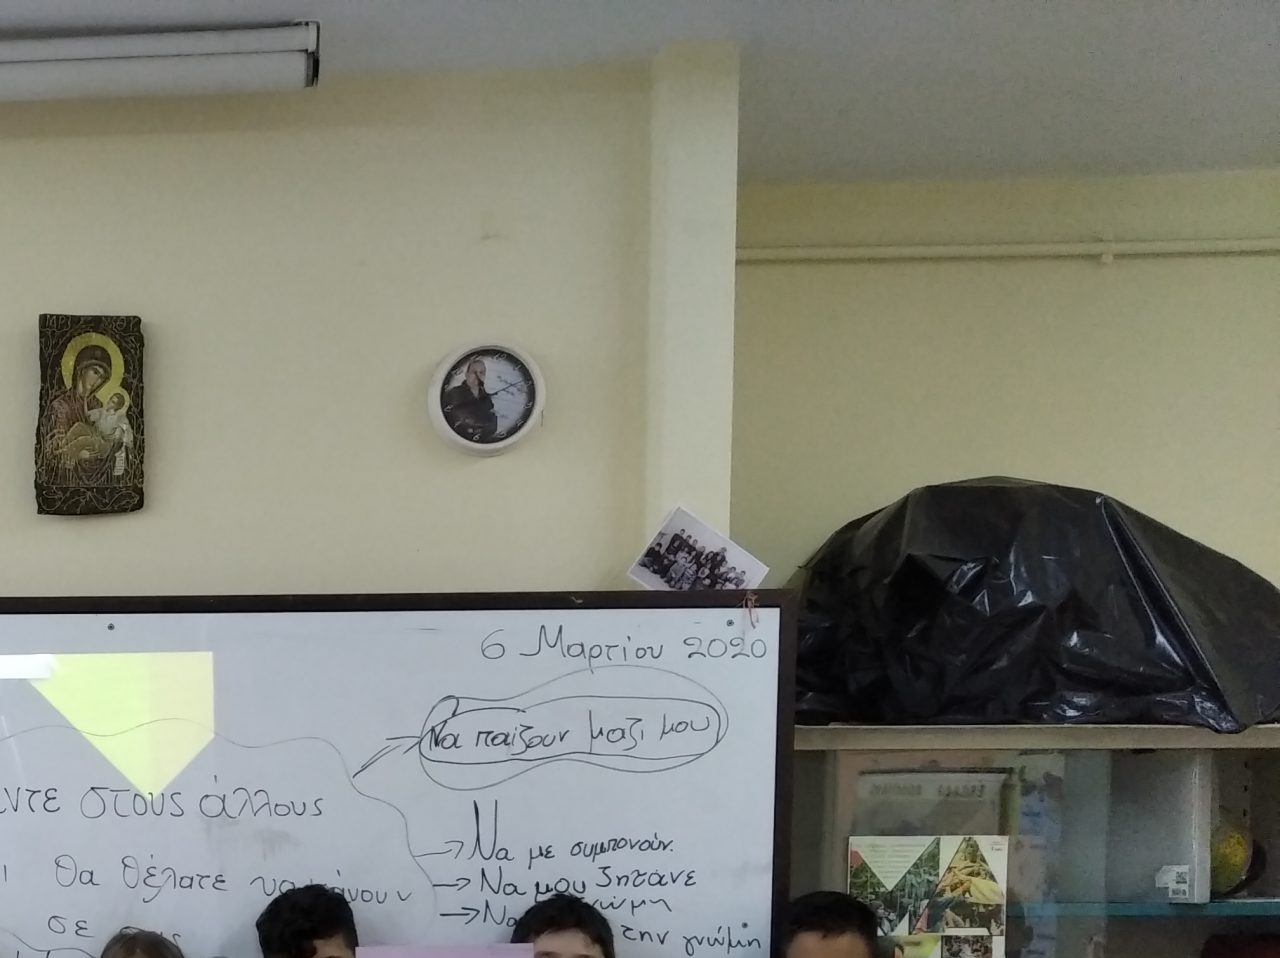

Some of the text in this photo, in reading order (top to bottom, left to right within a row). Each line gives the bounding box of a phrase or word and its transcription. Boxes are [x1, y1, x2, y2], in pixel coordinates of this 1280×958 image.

[481, 624, 767, 674] 6 Μαρτίου 2020
[659, 713, 710, 741] μου
[80, 786, 185, 819] στους
[199, 774, 324, 819] άλλους
[468, 800, 515, 861] Να
[528, 844, 556, 869] με
[480, 865, 527, 896] Να
[620, 924, 670, 944] την
